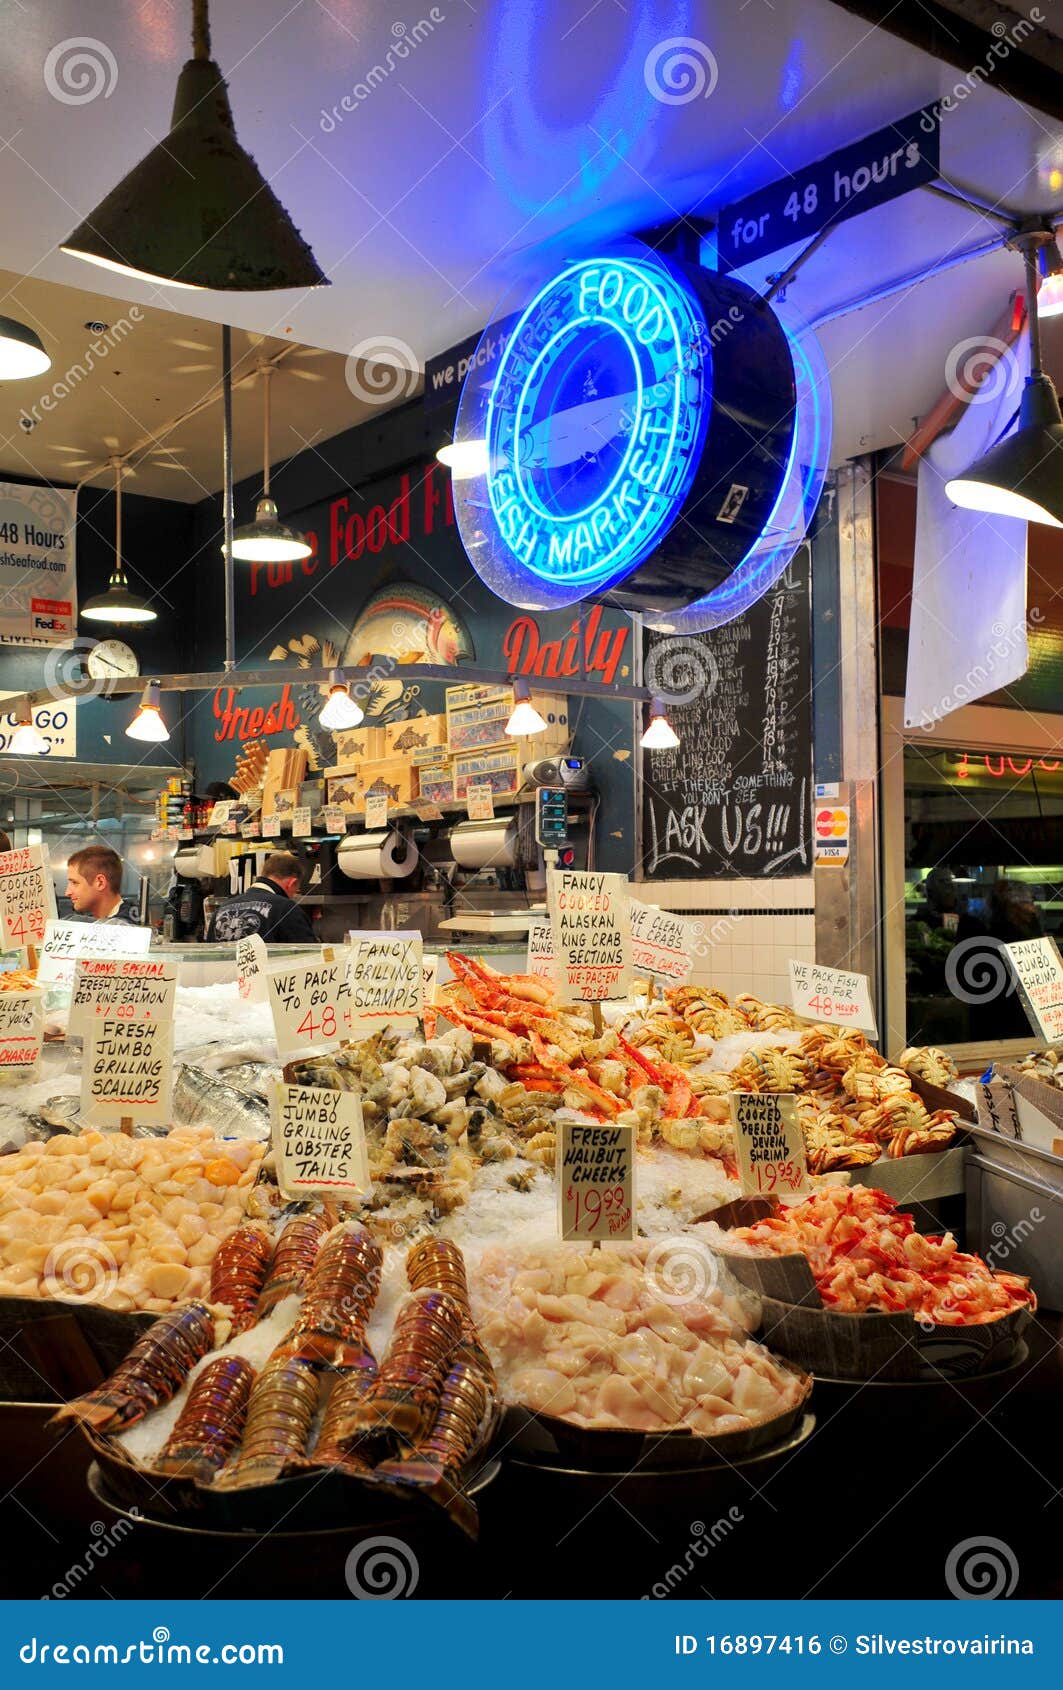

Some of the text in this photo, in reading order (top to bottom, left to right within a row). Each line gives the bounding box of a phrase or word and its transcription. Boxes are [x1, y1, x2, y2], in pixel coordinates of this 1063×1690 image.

[731, 141, 920, 249] for 48 hours
[579, 269, 664, 345] FOOD
[432, 363, 455, 390] we
[489, 414, 671, 566] FISH MARKET
[329, 473, 411, 566] Food
[0, 522, 65, 550] 48 Hours
[35, 617, 67, 631] FedEx
[503, 604, 629, 684] Daily
[35, 710, 68, 730] GO
[213, 683, 300, 742] Fresh
[661, 780, 679, 792] IF
[732, 774, 795, 790] SOMETHING
[681, 792, 698, 805] YOU
[735, 788, 758, 803] SEE
[666, 804, 712, 854] ASK
[0, 873, 41, 892] COOKED
[563, 874, 606, 896] FANCY
[6, 884, 43, 904] SHRIMP
[5, 901, 45, 916] IN SHELL
[560, 912, 615, 930] ALASKAN
[629, 906, 685, 936] WE CLEAN
[53, 930, 73, 942] WE
[561, 932, 621, 947] KING CRAB
[647, 931, 683, 949] CRABS
[44, 942, 75, 956] GIFT
[358, 940, 414, 963] FANCY
[569, 950, 623, 964] SECTIONS
[1010, 941, 1043, 958] FANCY
[122, 961, 165, 976] SPECIAL
[354, 963, 419, 981] GRILLING
[1016, 955, 1050, 973] JUMBO
[79, 978, 110, 991] FRESH
[116, 979, 149, 992] LOCAL
[273, 975, 297, 996] WE
[304, 967, 338, 991] PACK
[792, 964, 859, 989] WE PACK FISH
[1022, 967, 1057, 990] SHRIMP
[74, 990, 167, 1005] RED KING SALMON
[354, 987, 419, 1008] SCAMPIS
[795, 979, 853, 1000] TO GO FOR
[282, 994, 301, 1012] TO
[311, 990, 328, 1005] GO
[807, 995, 833, 1016] 48
[7, 1012, 33, 1028] YOUR
[297, 1005, 337, 1040] 48
[103, 1021, 157, 1040] FRESH
[96, 1041, 153, 1058] JUMBO
[93, 1059, 163, 1077] GRILLING
[91, 1079, 162, 1098] SCALLOPS
[288, 1088, 342, 1107] FANCY
[739, 1094, 780, 1108] FANCY
[283, 1105, 338, 1125] JUMBO
[737, 1107, 781, 1122] COOKED
[283, 1124, 351, 1143] GRILLING
[570, 1127, 622, 1147] FRESH
[741, 1122, 780, 1136] PEELED
[285, 1142, 353, 1160] LOBSTER
[752, 1134, 786, 1149] DEVEIN
[564, 1147, 626, 1167] HALIBUT
[750, 1147, 790, 1162] SHRIMP
[295, 1160, 349, 1179] TAILS
[571, 1165, 627, 1184] CHEEKS
